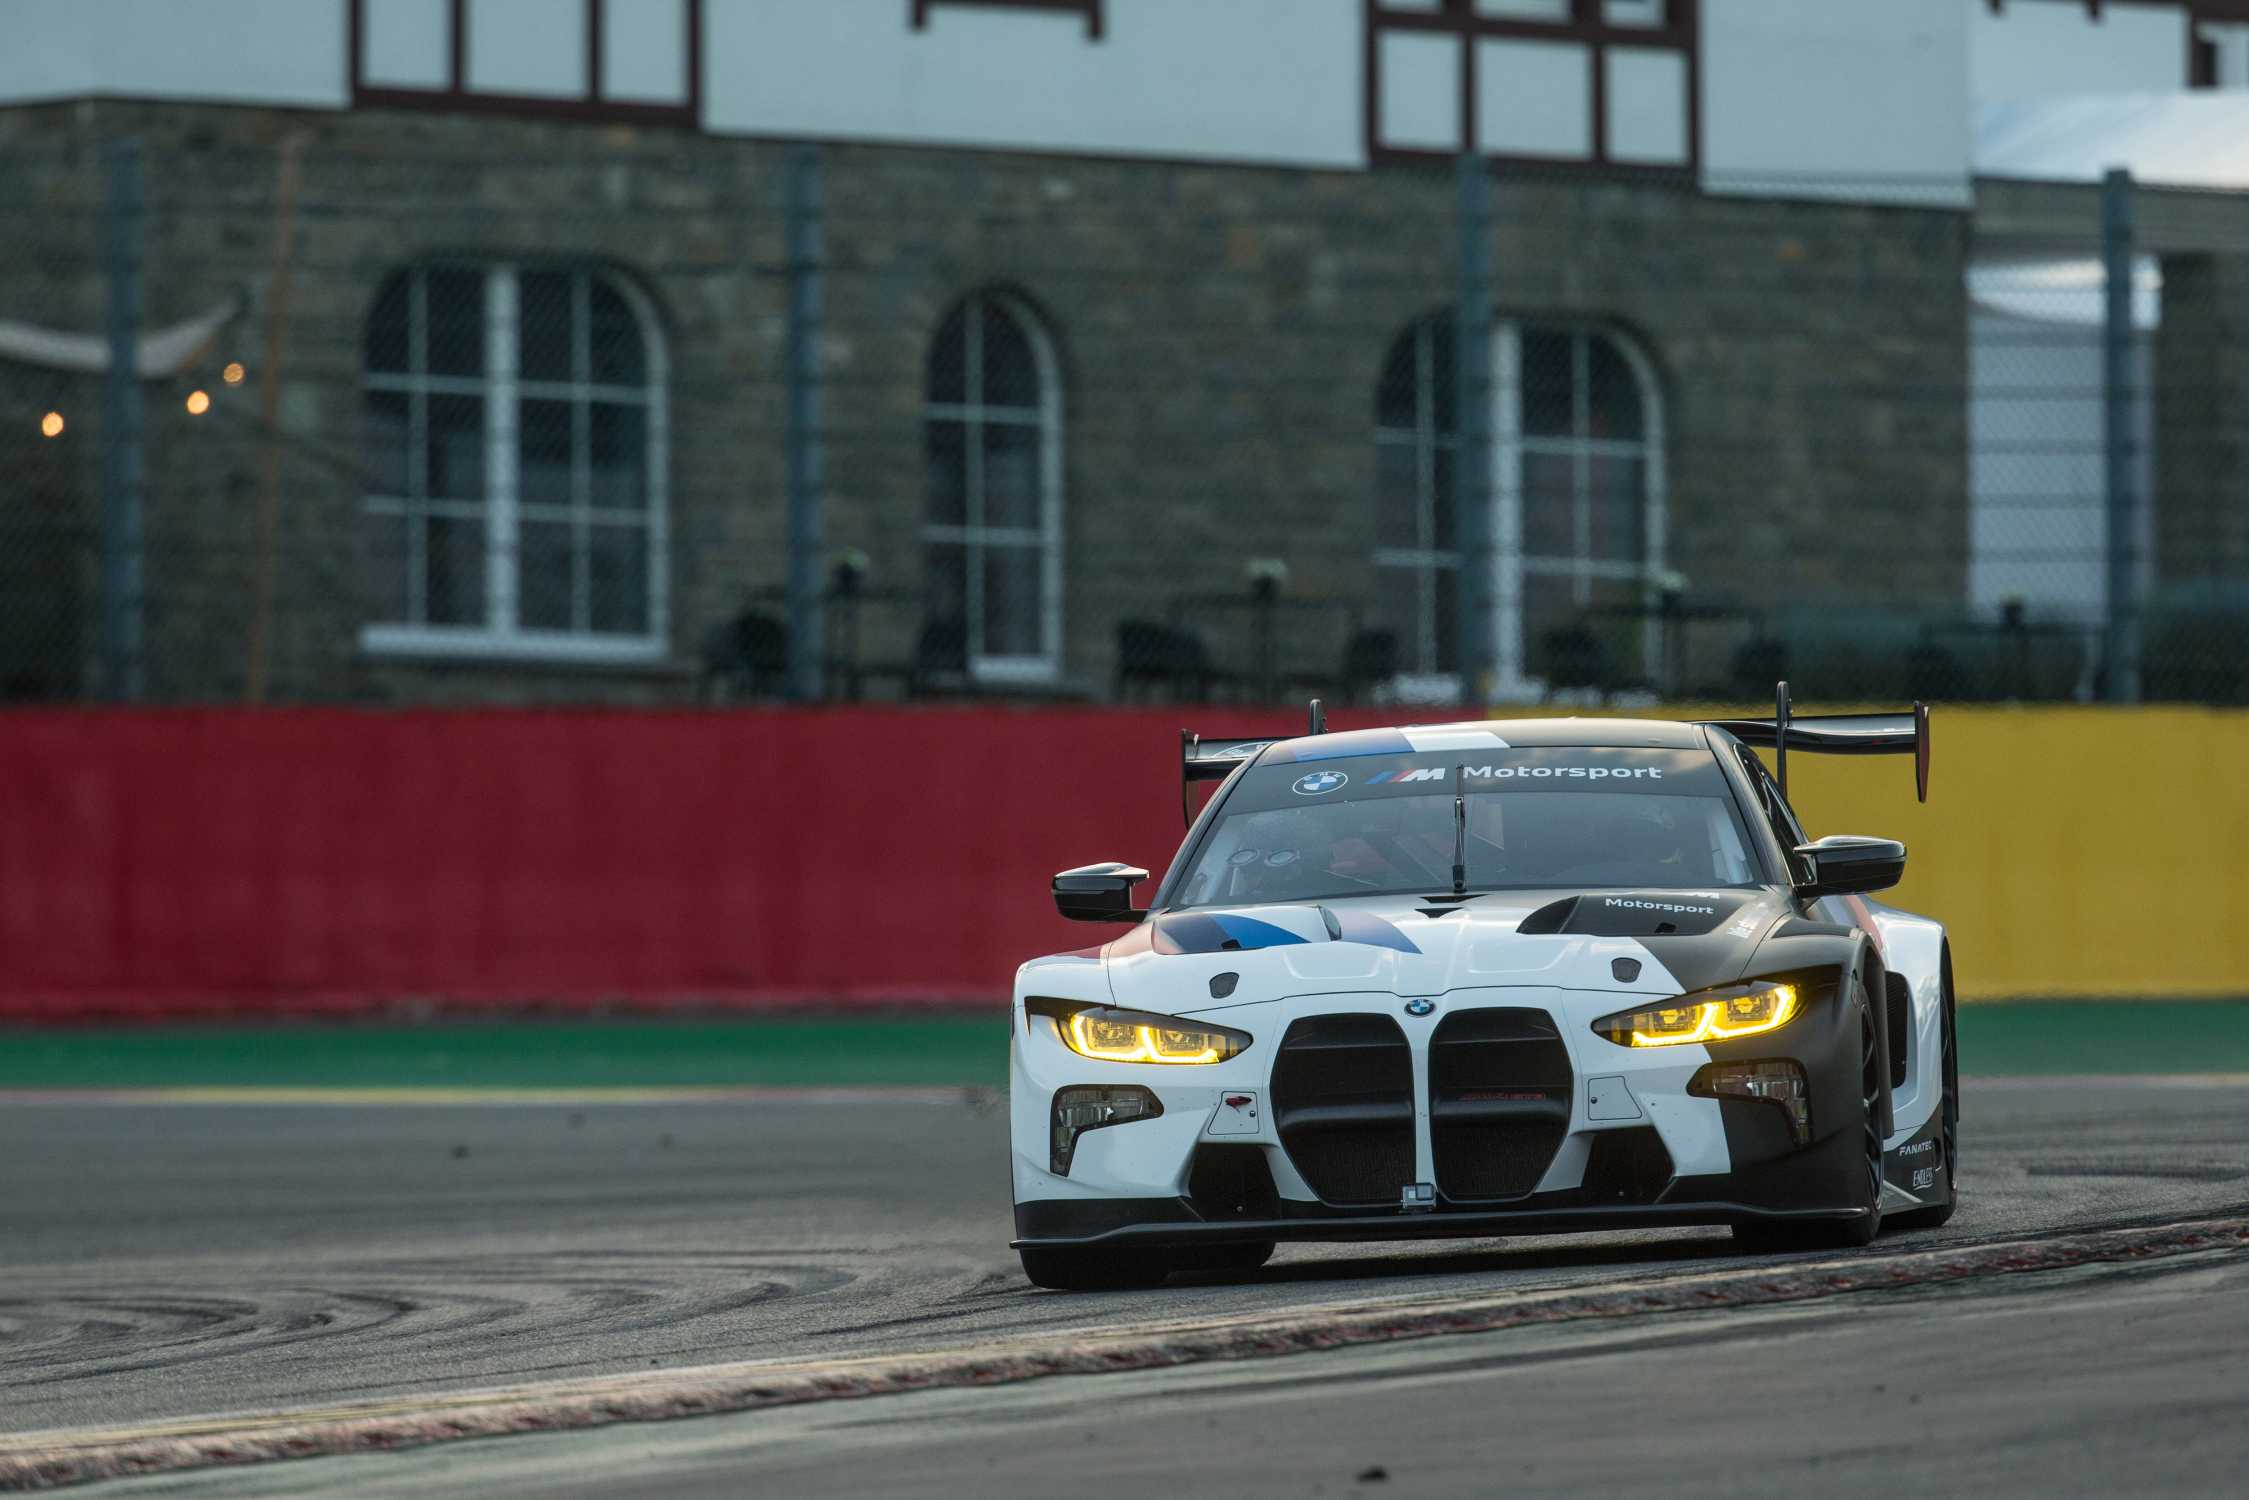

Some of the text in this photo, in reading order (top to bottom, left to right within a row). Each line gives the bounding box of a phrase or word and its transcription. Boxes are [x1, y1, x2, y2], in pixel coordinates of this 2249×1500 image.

[1463, 766, 1662, 779] Motorsport
[1605, 898, 1714, 914] Motorsport
[1899, 1140, 1933, 1157] FANATEC
